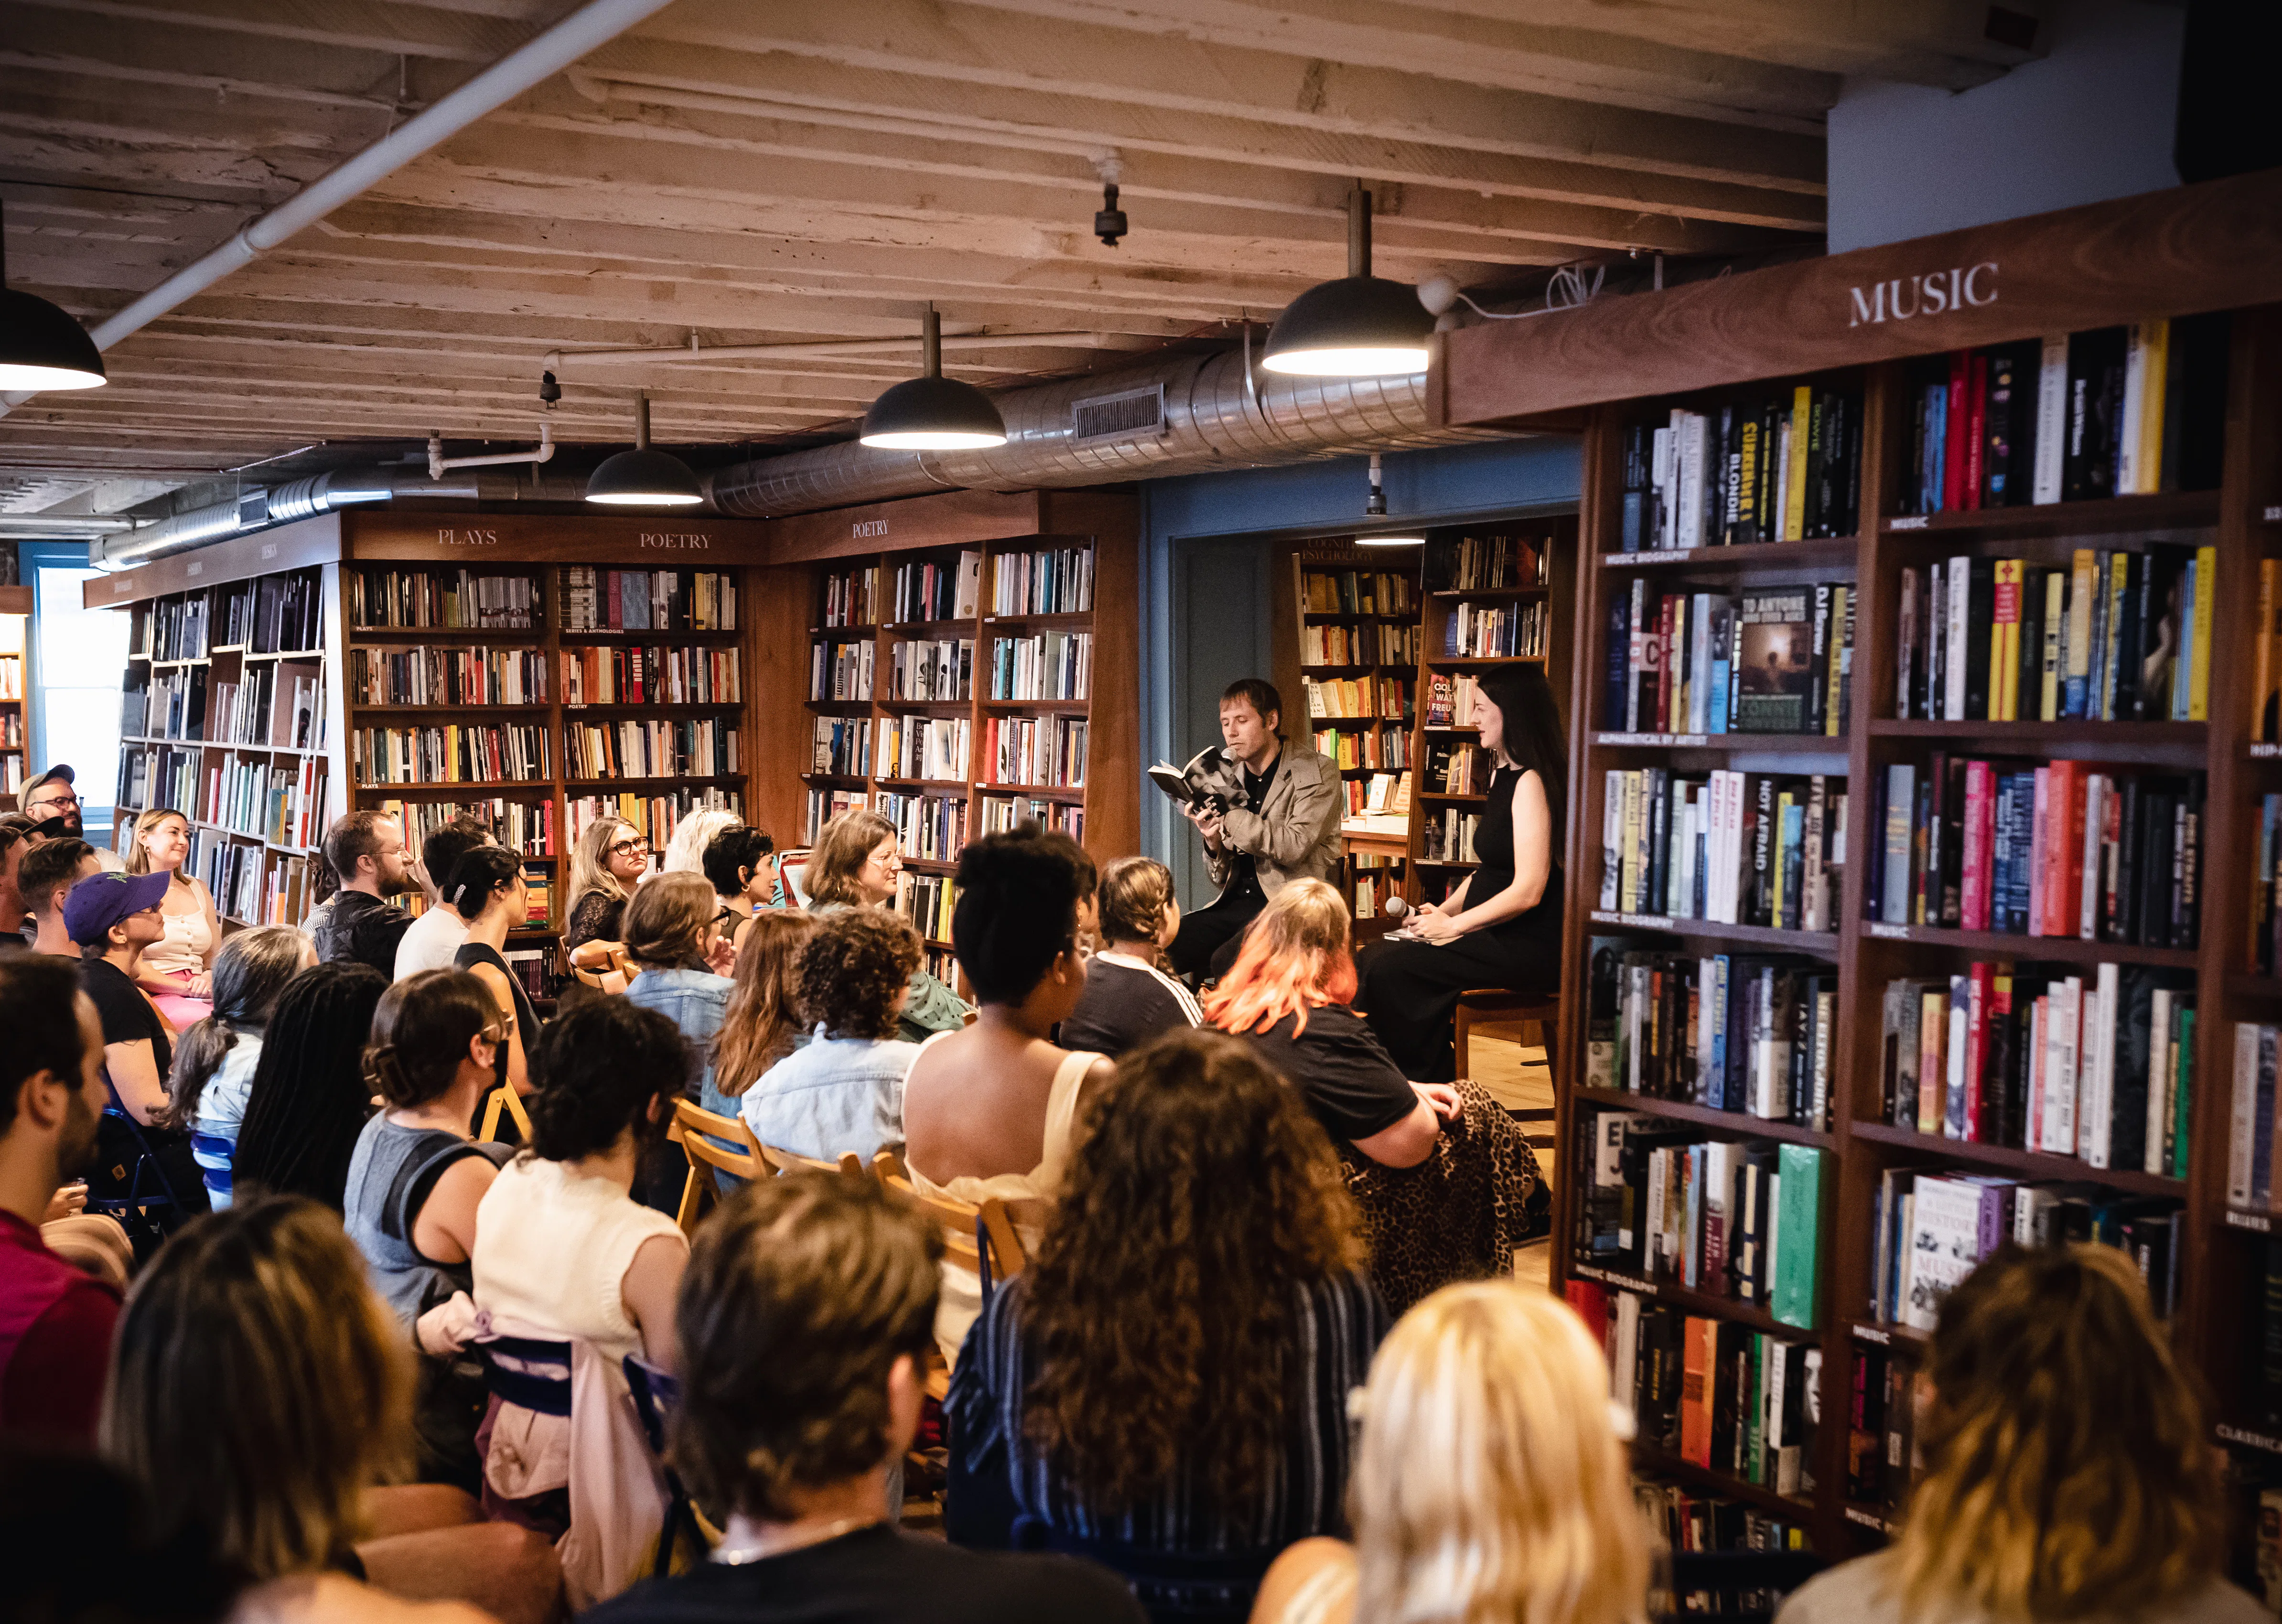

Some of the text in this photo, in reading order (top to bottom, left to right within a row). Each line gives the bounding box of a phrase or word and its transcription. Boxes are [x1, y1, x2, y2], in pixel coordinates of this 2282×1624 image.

[1849, 262, 1999, 327] MUSIC
[1726, 453, 1741, 524] BLONDIE
[438, 529, 497, 545] PLAYS
[853, 519, 889, 539] POETRY
[640, 533, 712, 549] POETRY
[1307, 538, 1366, 549] COGNITI
[1302, 549, 1373, 562] PSYCHOLOGY
[1815, 587, 1829, 607] DJ
[1758, 779, 1773, 813] NOT
[1754, 814, 1769, 871] AFRAID
